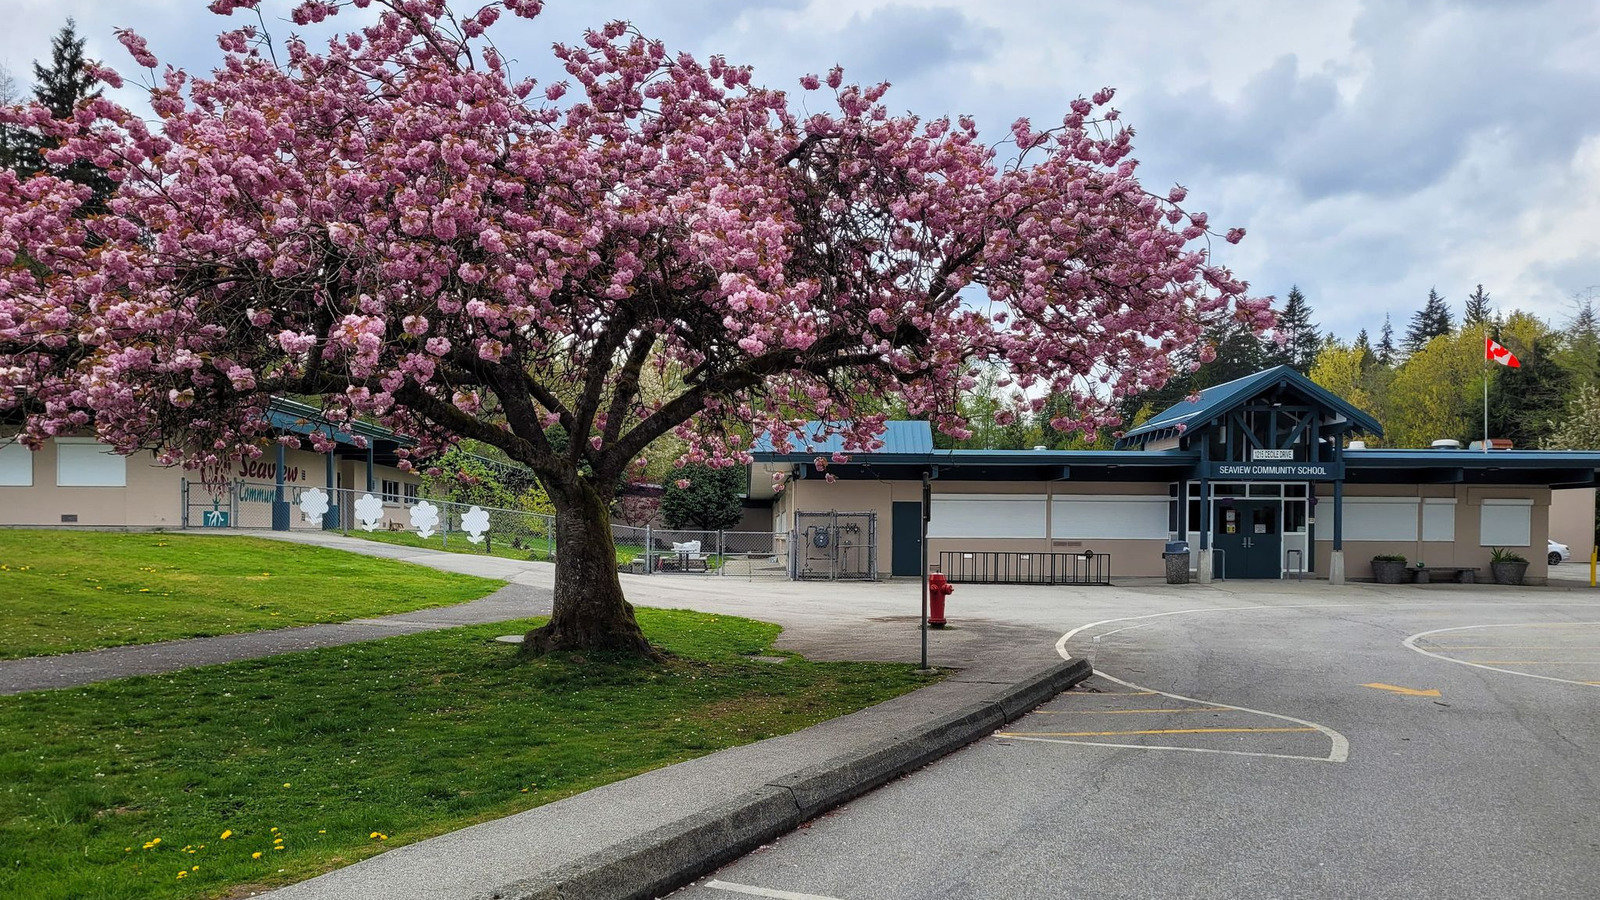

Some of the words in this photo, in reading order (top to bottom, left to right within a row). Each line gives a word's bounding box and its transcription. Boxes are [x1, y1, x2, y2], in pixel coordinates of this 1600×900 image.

[1219, 466, 1251, 474] SEAVIEW
[1252, 466, 1296, 475] COMMUNITY
[1297, 466, 1327, 475] SCHOOL
